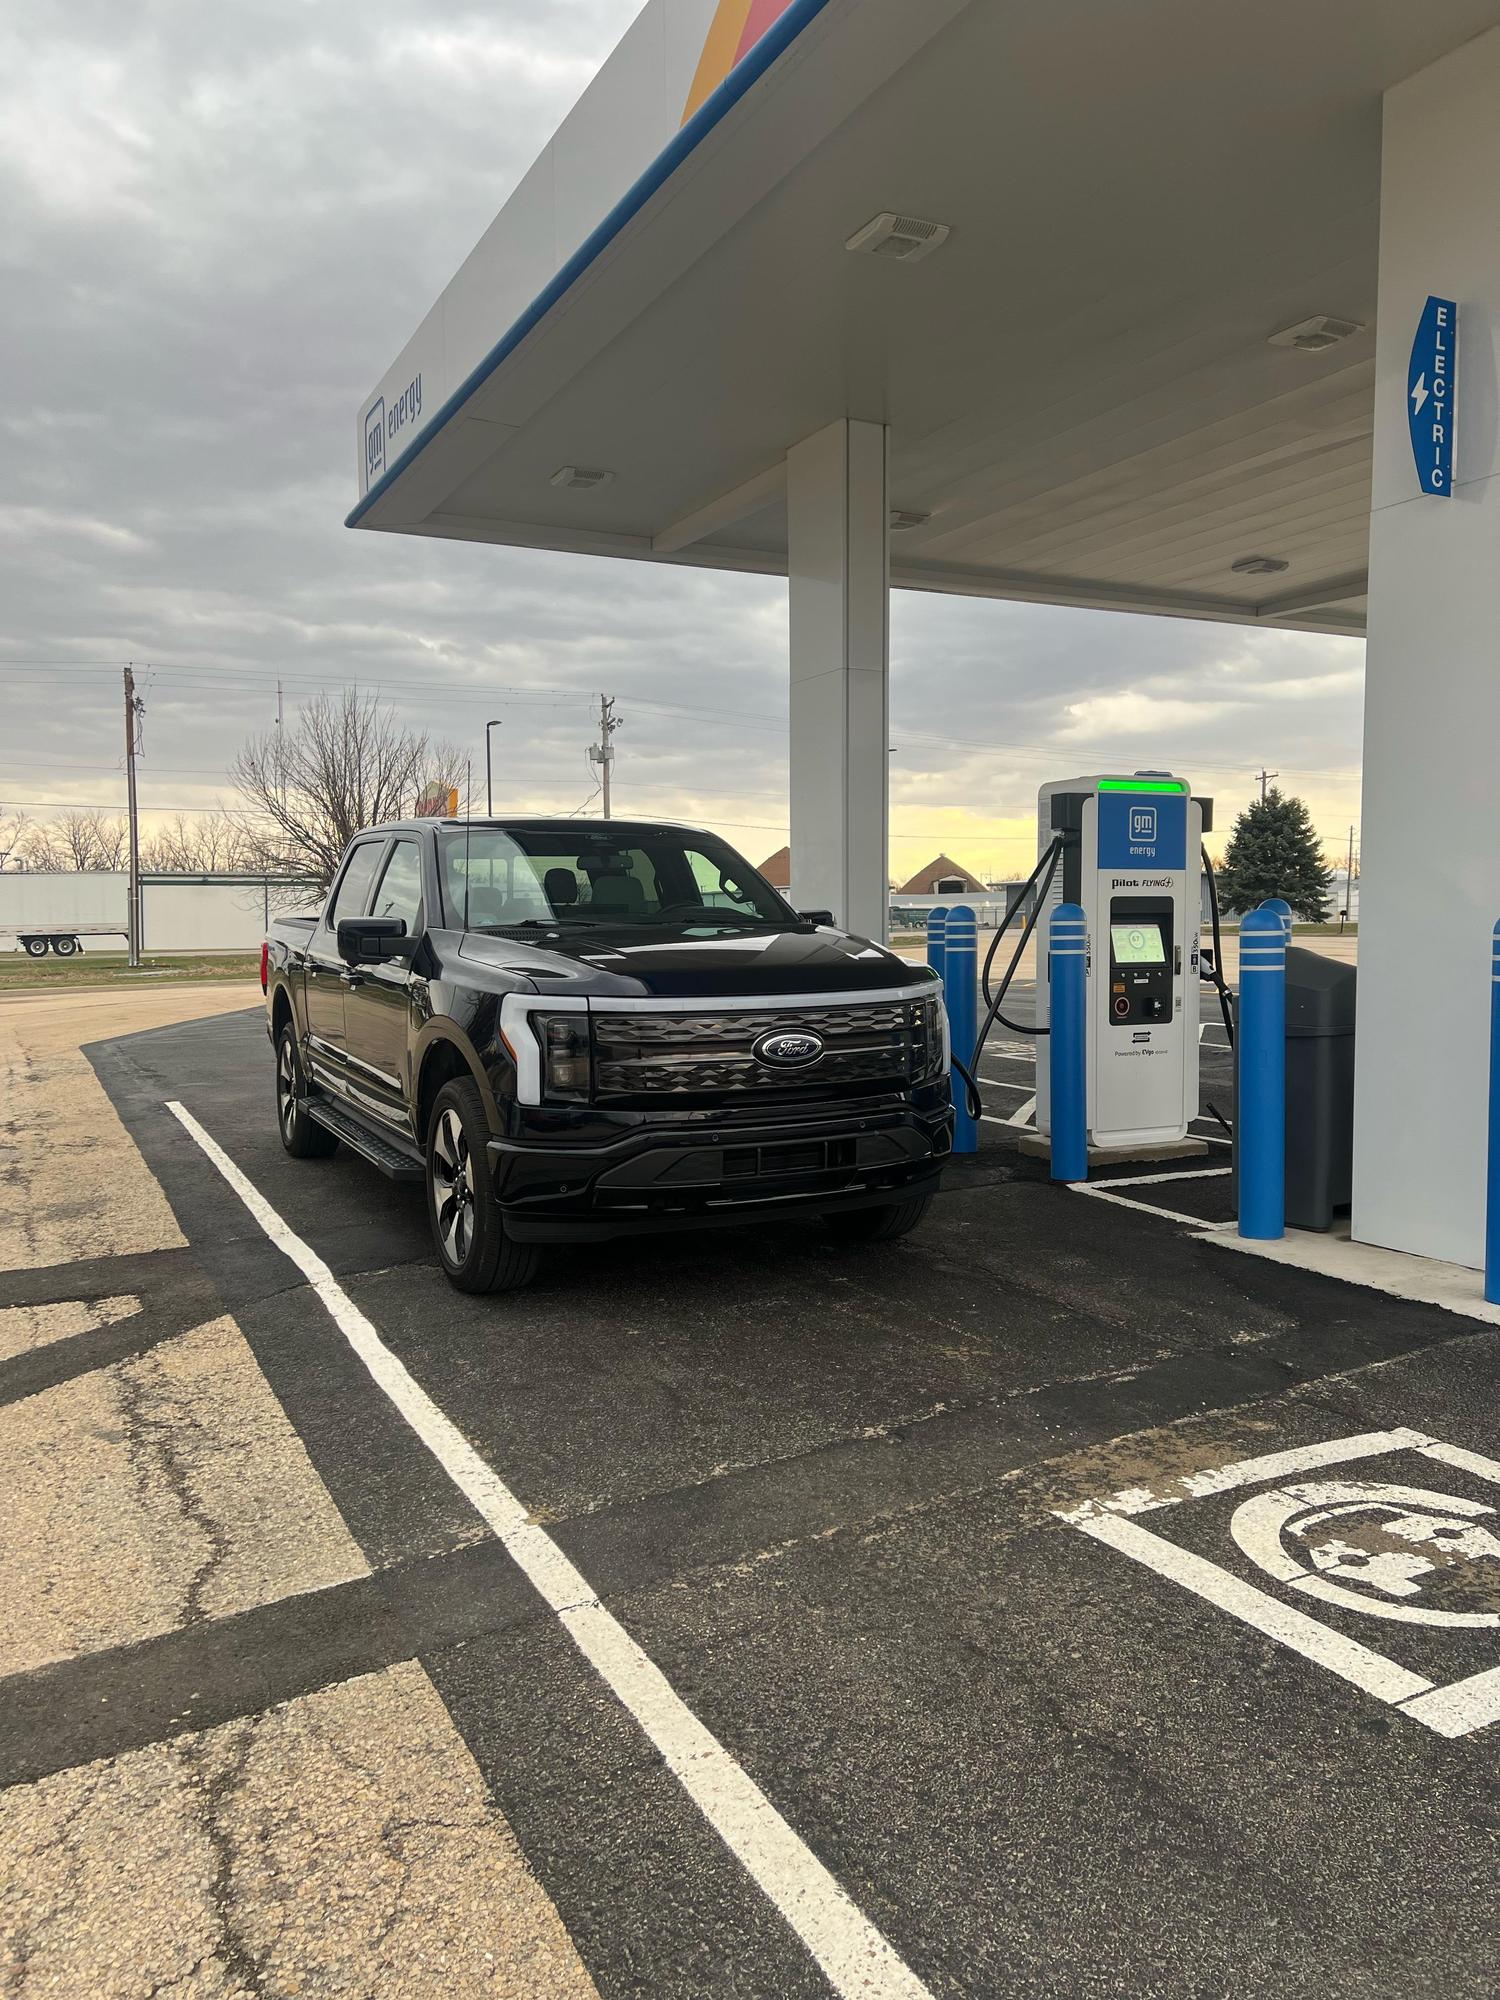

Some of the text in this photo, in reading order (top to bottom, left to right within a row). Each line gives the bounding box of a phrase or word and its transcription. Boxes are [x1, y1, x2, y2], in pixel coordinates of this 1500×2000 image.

[1431, 306, 1447, 489] ELECTRIC
[368, 372, 422, 475] gm energy
[1134, 815, 1152, 833] gm
[1129, 846, 1156, 857] energy
[777, 1040, 809, 1056] Ford
